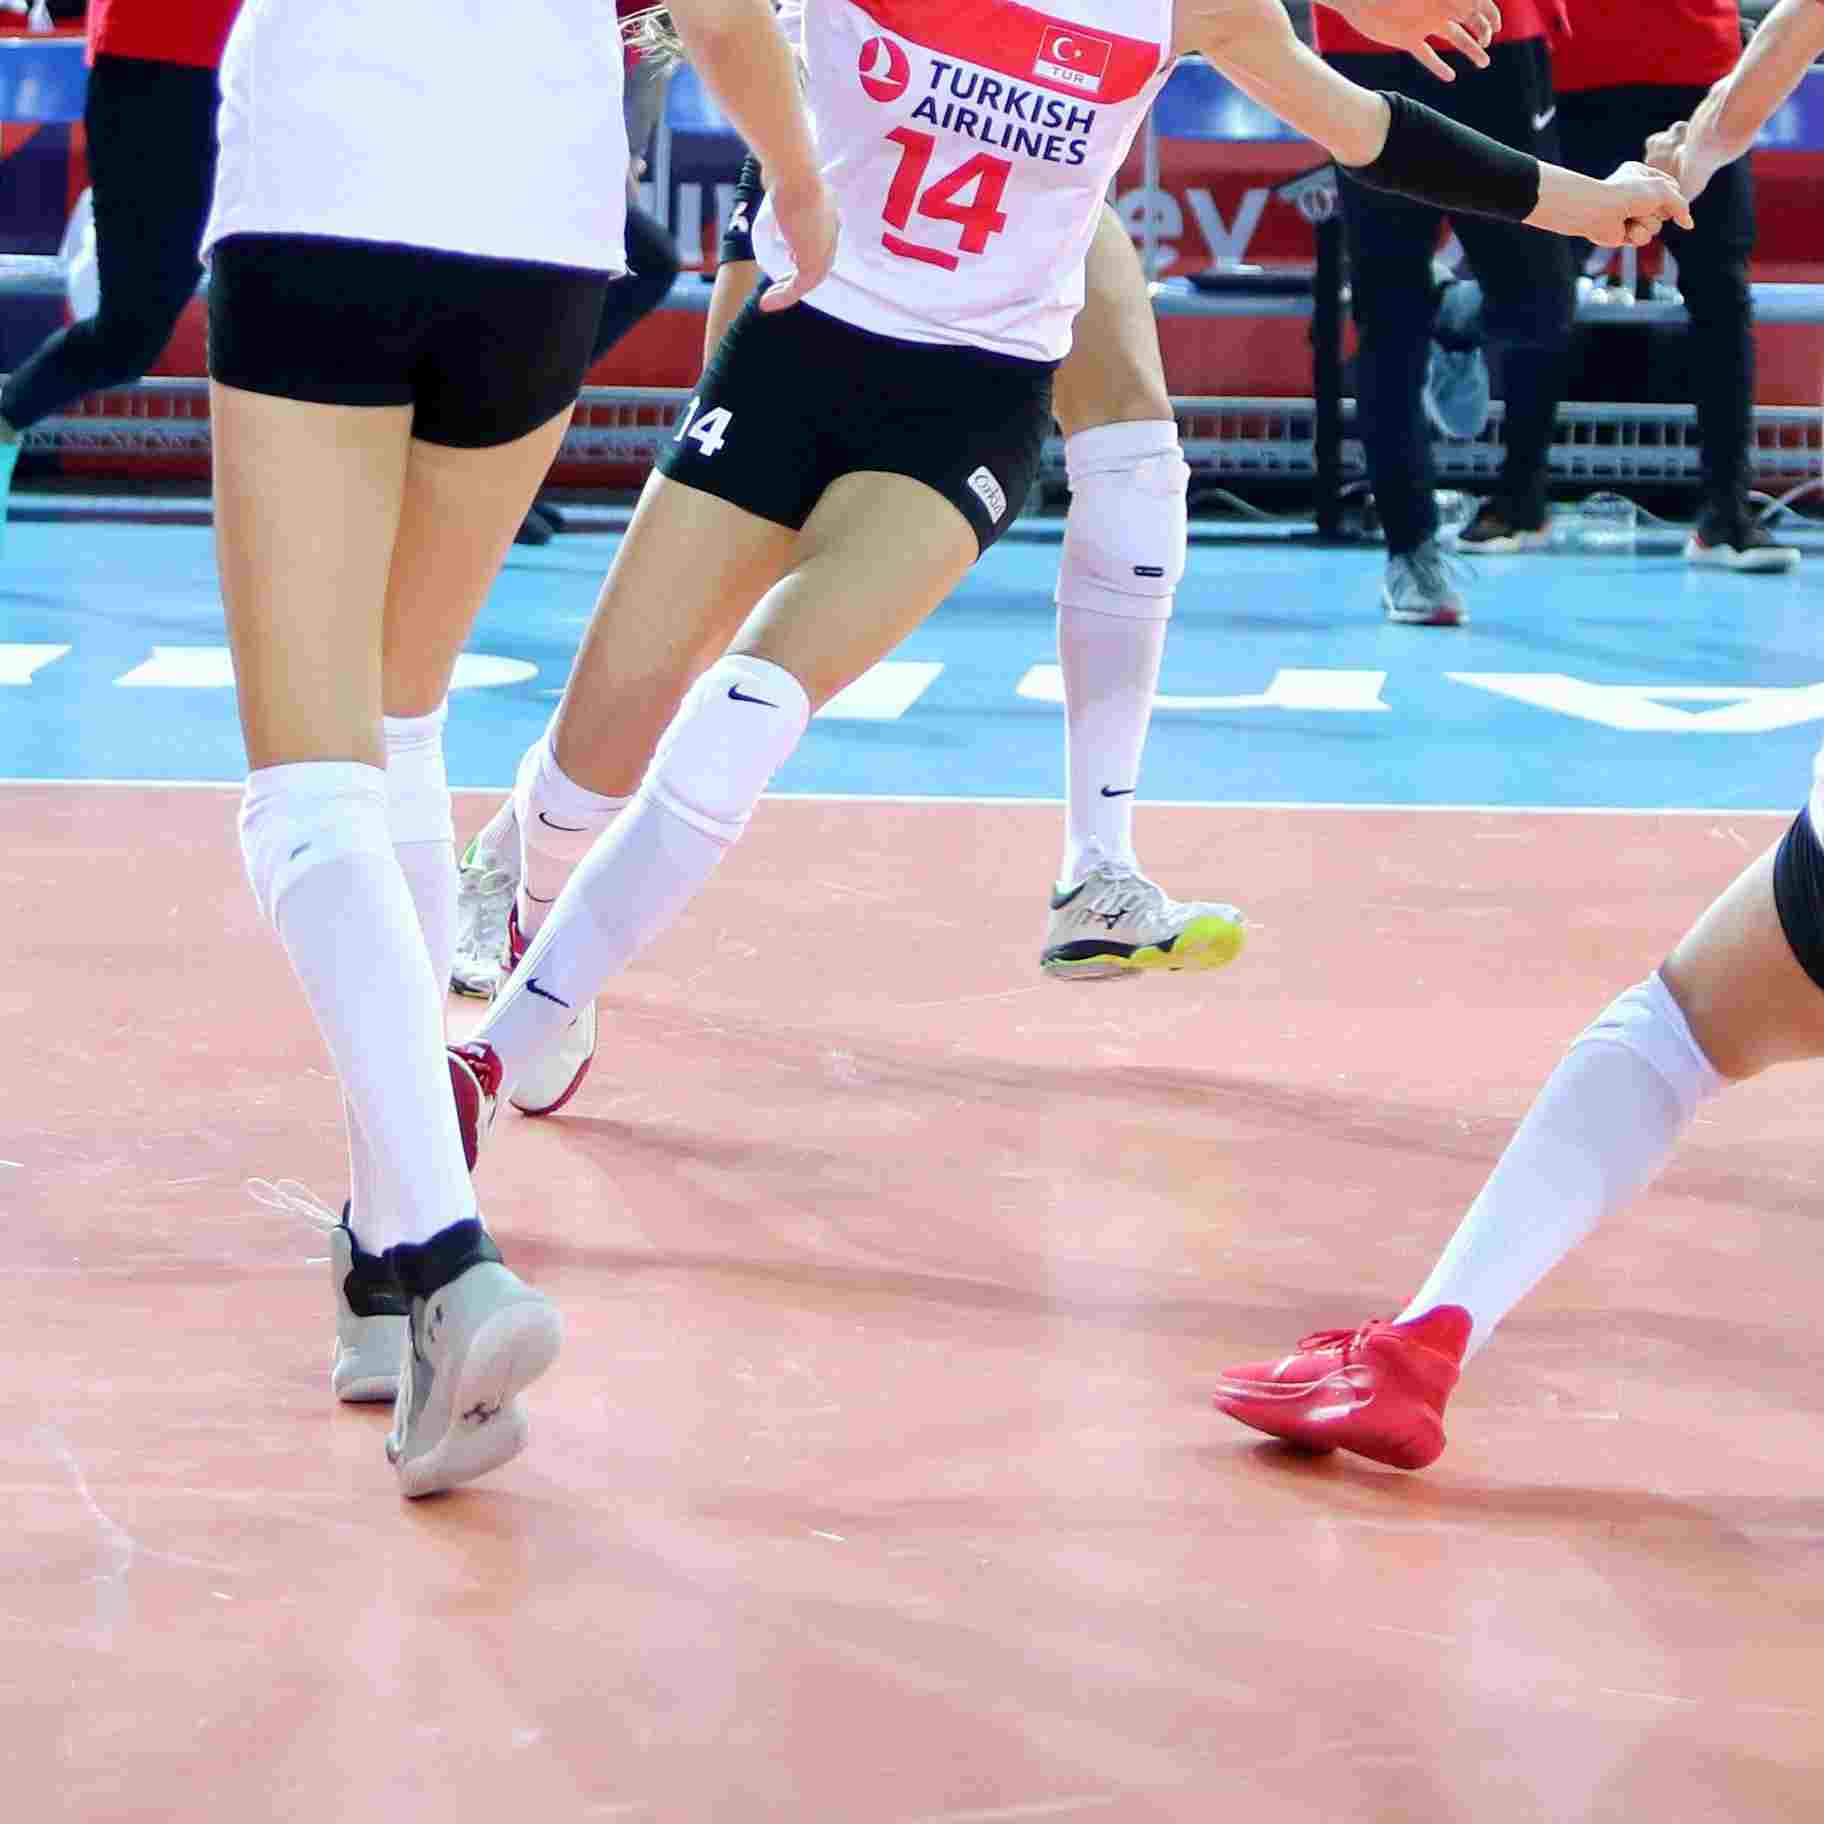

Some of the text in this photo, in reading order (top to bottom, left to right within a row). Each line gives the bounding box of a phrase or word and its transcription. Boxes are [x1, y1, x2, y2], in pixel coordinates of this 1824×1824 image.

[929, 60, 1097, 135] TURKISH
[1049, 67, 1087, 85] TUR
[911, 95, 1089, 166] AIRLINES
[881, 125, 1014, 255] 14
[673, 395, 734, 458] 14
